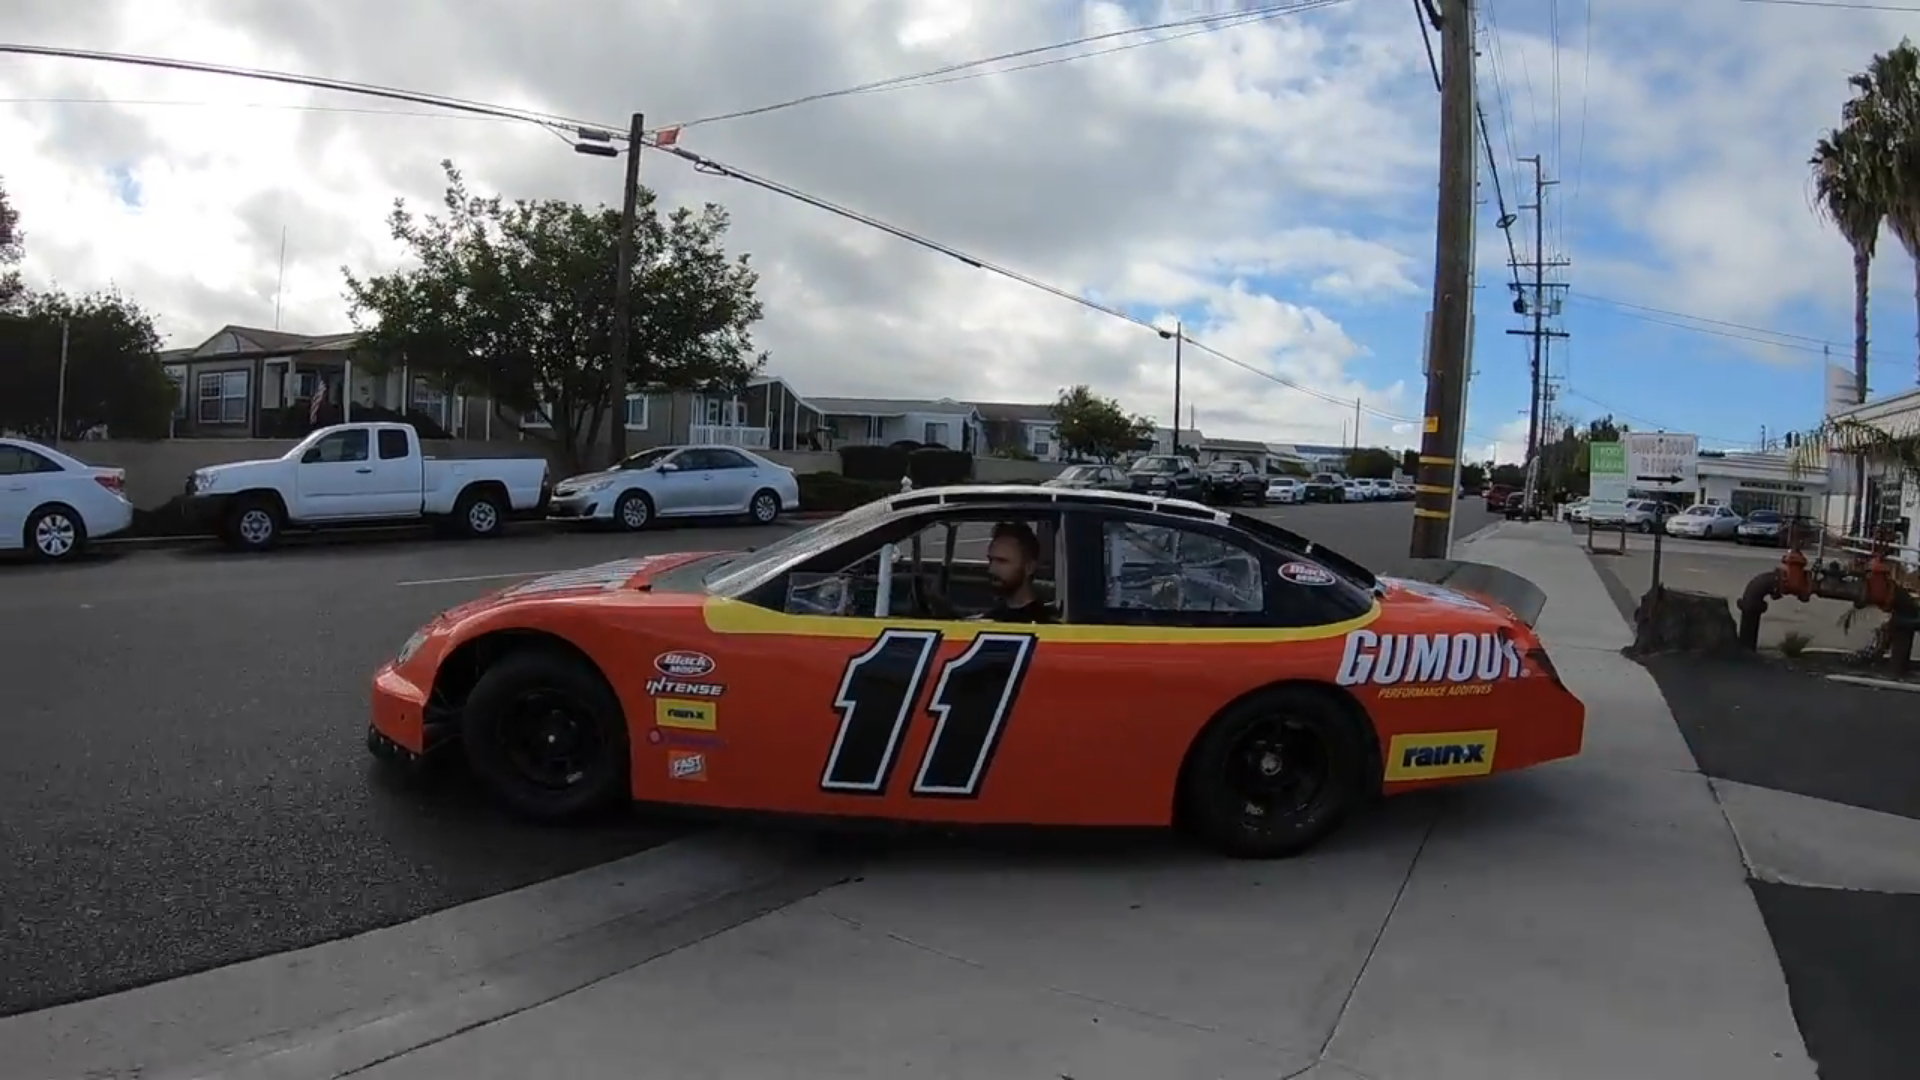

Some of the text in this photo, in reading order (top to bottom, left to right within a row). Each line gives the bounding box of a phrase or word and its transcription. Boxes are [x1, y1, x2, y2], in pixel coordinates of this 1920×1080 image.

[664, 654, 707, 666] Black
[646, 677, 723, 696] INTENSE
[1377, 683, 1493, 699] PERFORMANCE ADDITIVES
[821, 628, 1038, 799] 11
